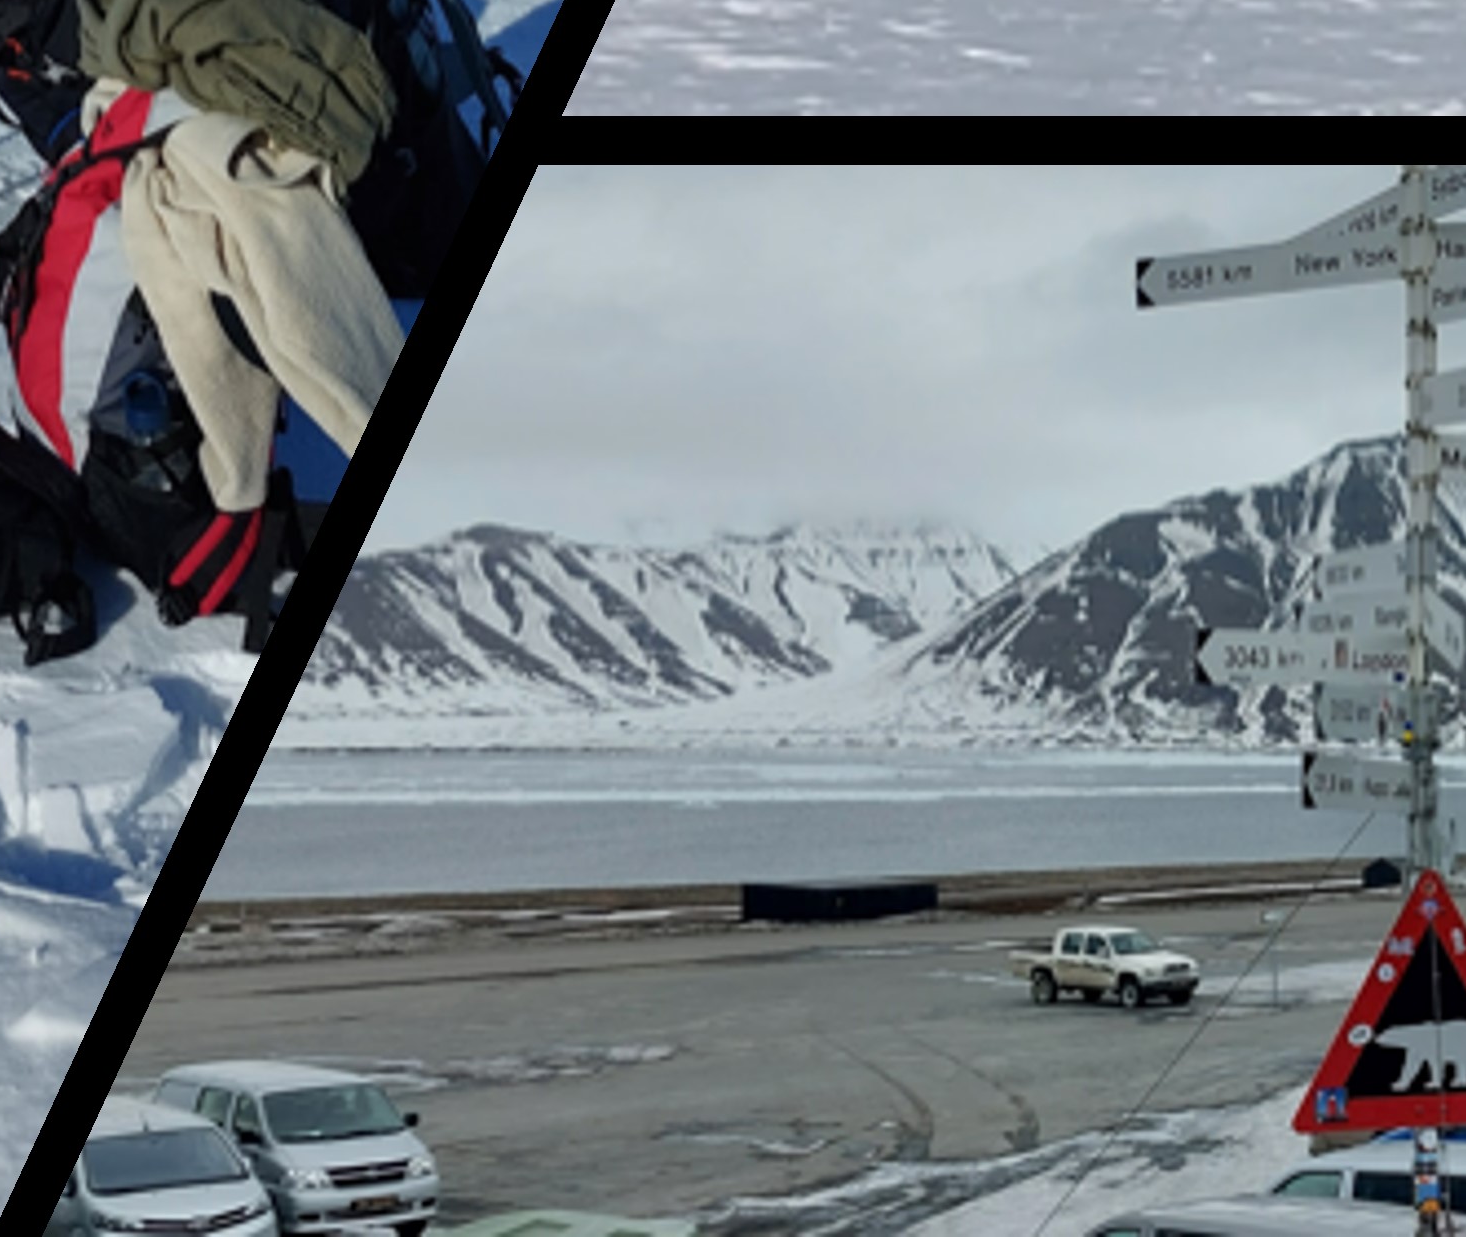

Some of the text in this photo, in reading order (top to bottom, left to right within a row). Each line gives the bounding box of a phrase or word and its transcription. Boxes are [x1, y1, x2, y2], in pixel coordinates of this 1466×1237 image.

[1222, 265, 1252, 283] km
[1294, 253, 1341, 276] New
[1351, 248, 1398, 268] York
[1223, 644, 1410, 672] 3043 km London
